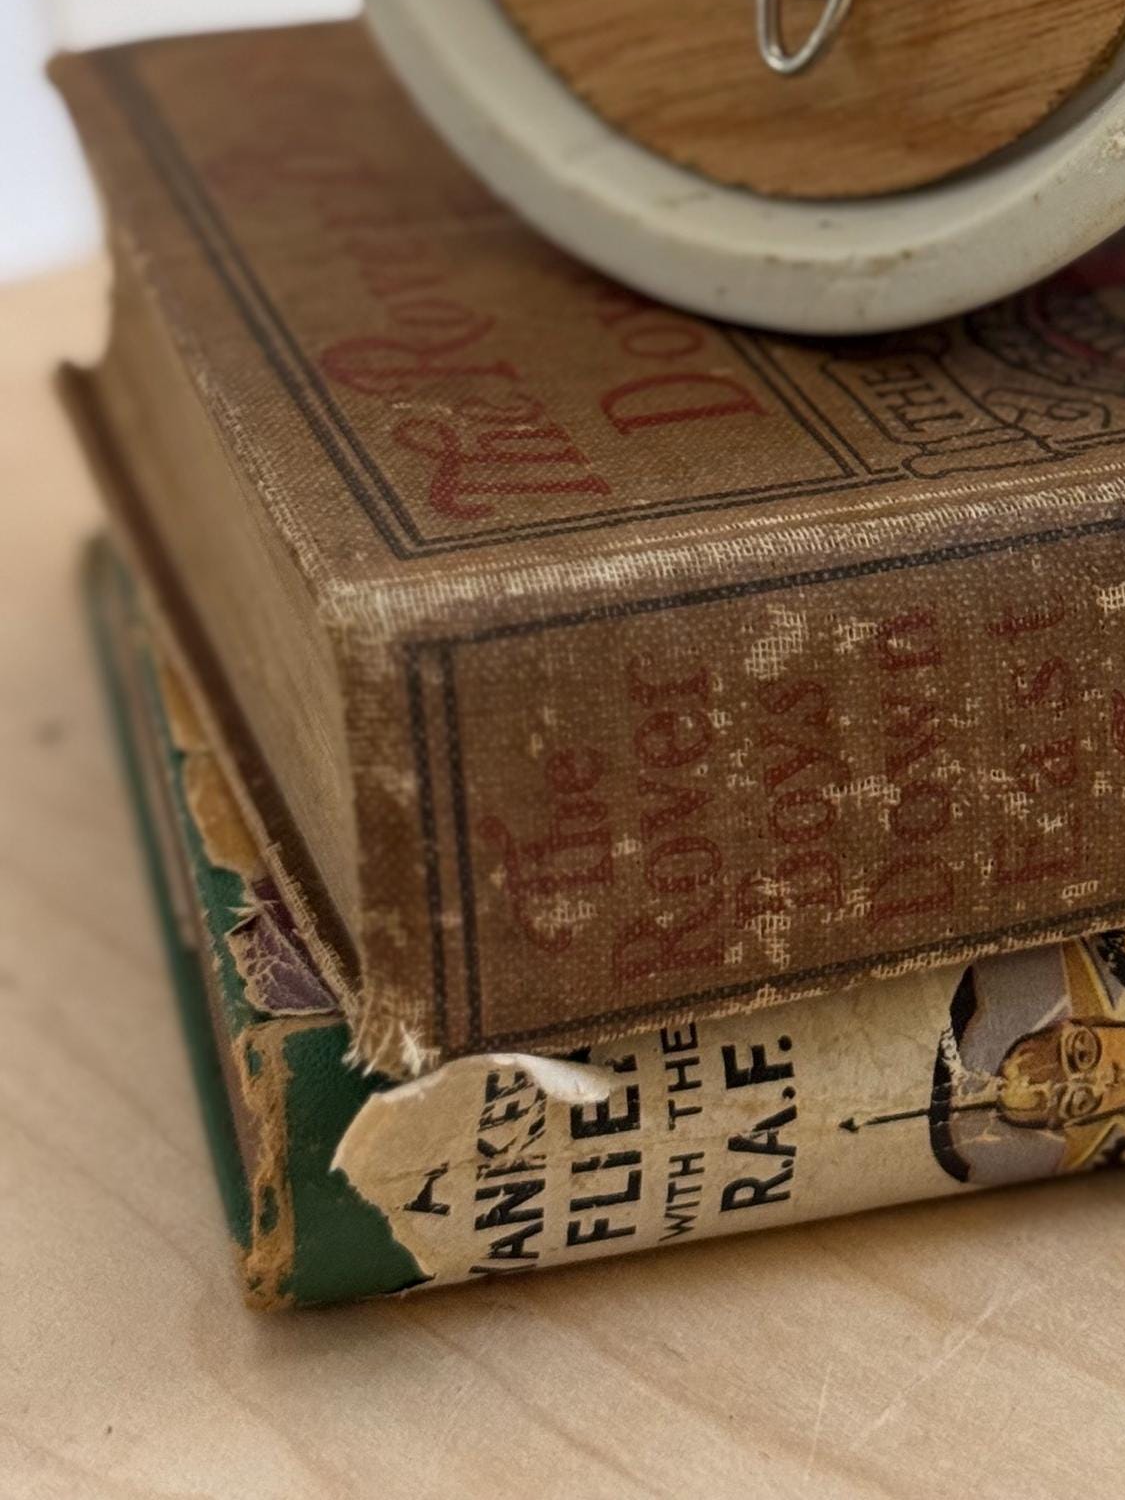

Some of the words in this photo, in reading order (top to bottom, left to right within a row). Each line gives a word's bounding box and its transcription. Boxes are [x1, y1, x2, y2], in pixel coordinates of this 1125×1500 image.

[393, 395, 612, 520] The
[859, 358, 965, 433] THE
[614, 652, 730, 987] Rover
[736, 674, 852, 928] Boys
[869, 607, 957, 933] Down
[987, 592, 1081, 887] East
[479, 744, 614, 954] The
[660, 1021, 704, 1131] THE
[720, 1033, 798, 1213] R.A.F.
[402, 1161, 451, 1216] A
[659, 1151, 706, 1243] WITH
